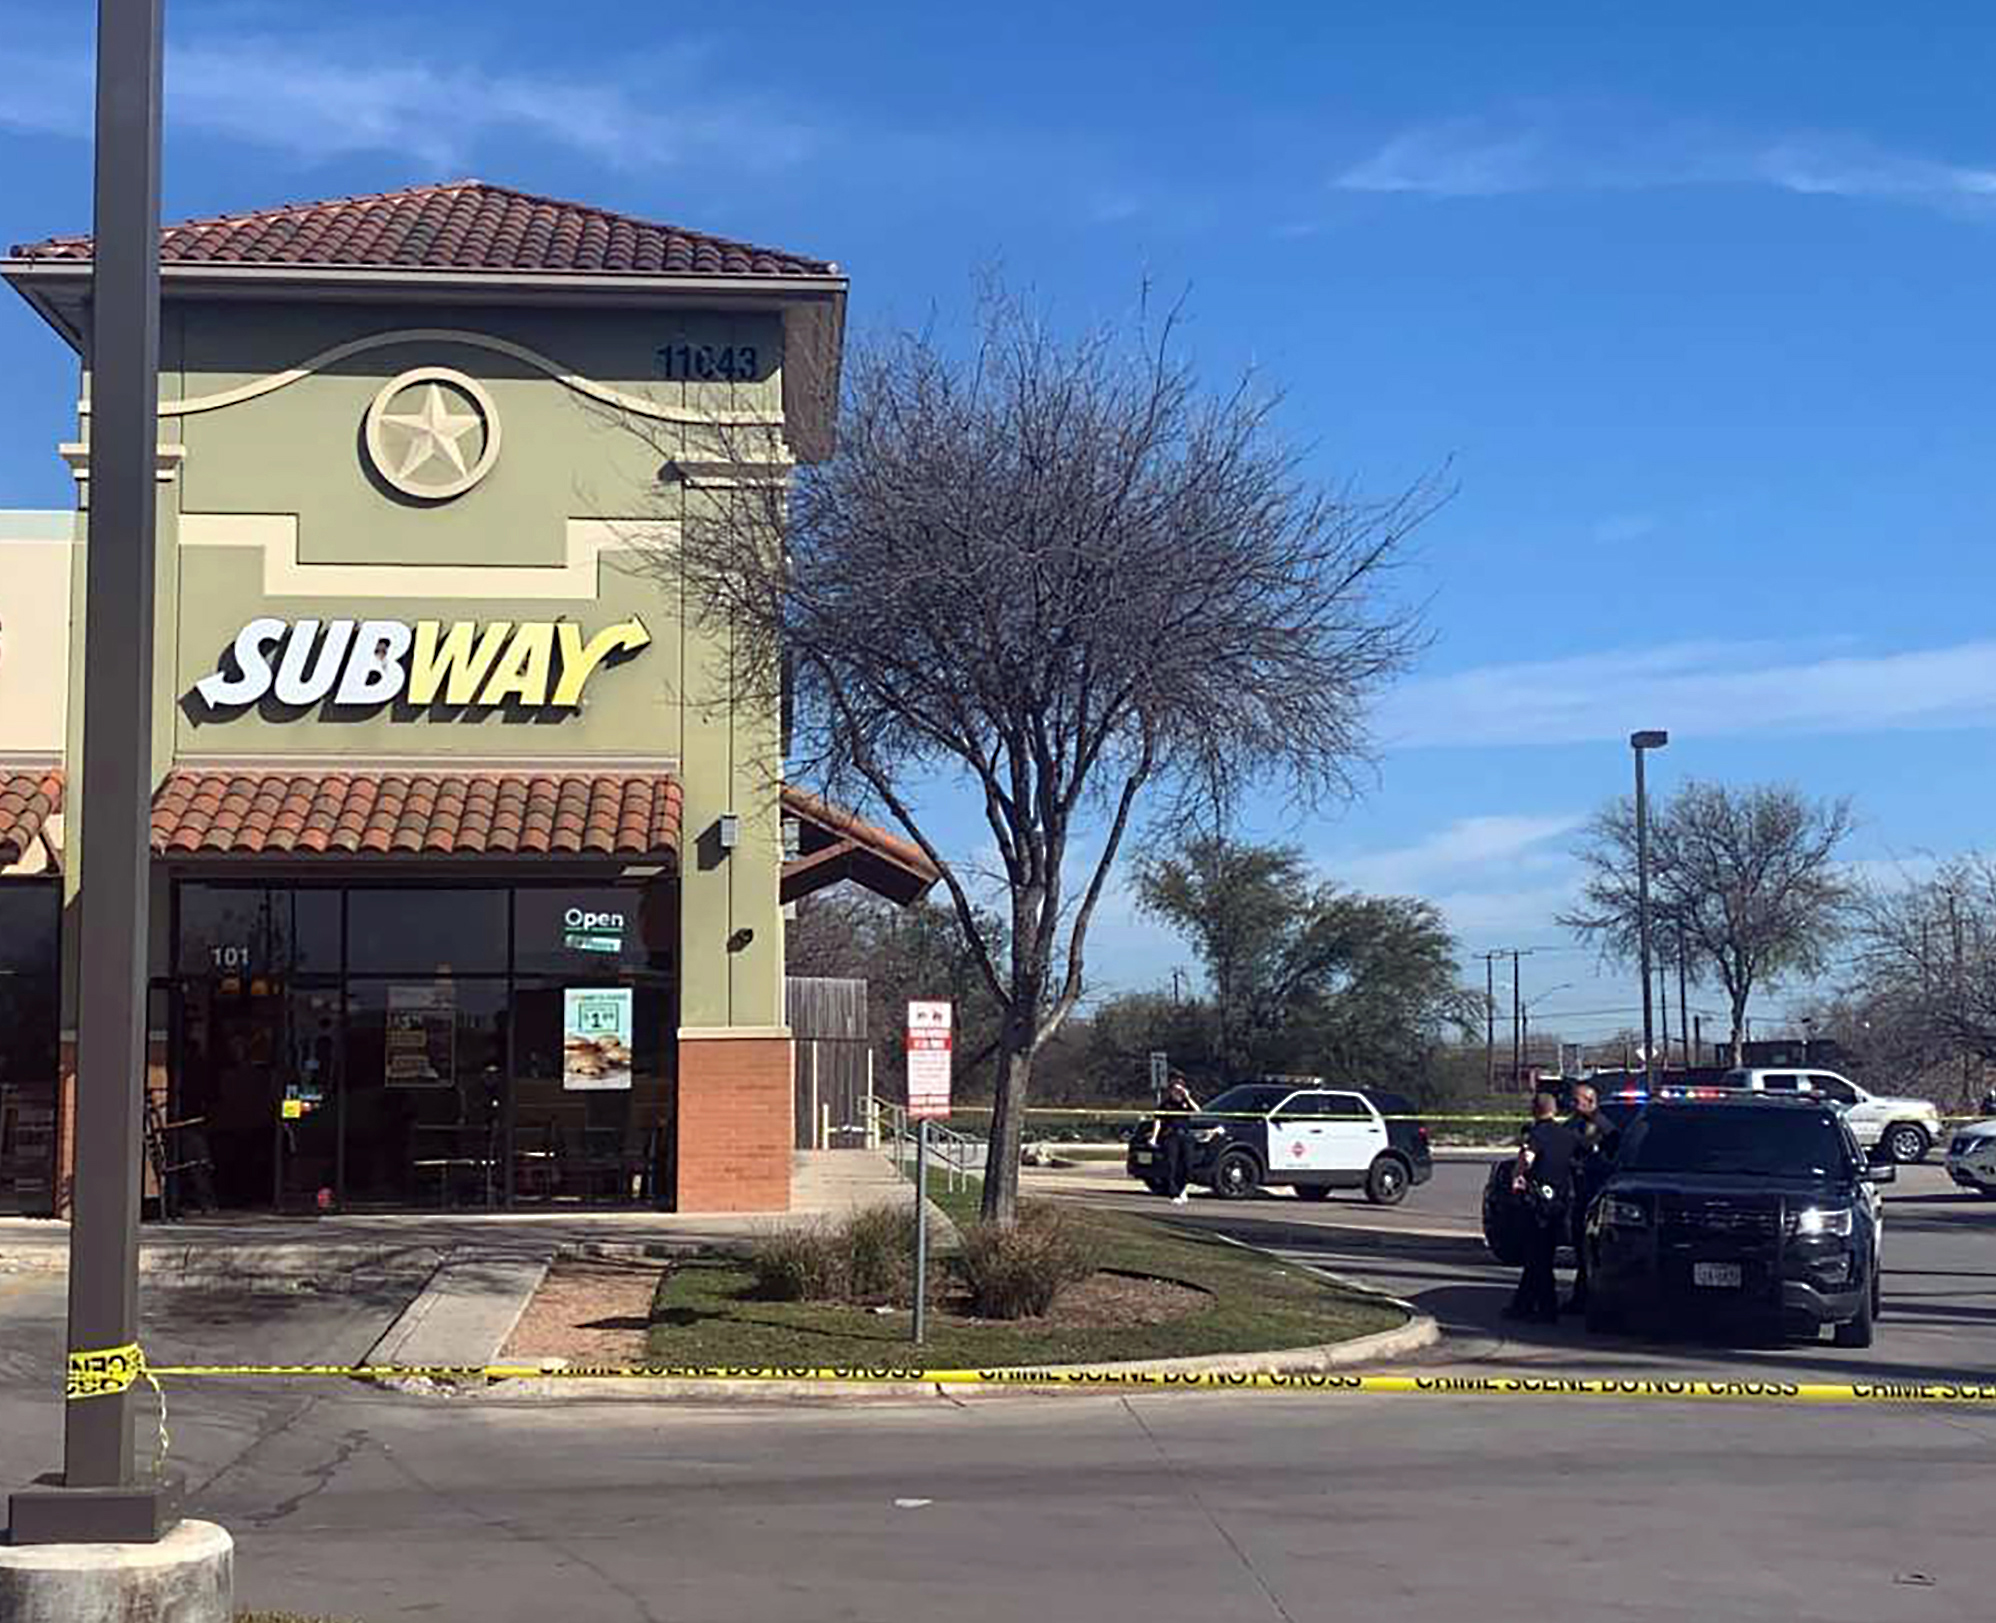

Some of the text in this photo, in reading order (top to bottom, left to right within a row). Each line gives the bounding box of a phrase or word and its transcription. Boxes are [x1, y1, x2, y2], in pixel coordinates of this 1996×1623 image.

[195, 616, 652, 709] SUBWAY
[565, 908, 624, 931] Open
[210, 947, 249, 966] 101
